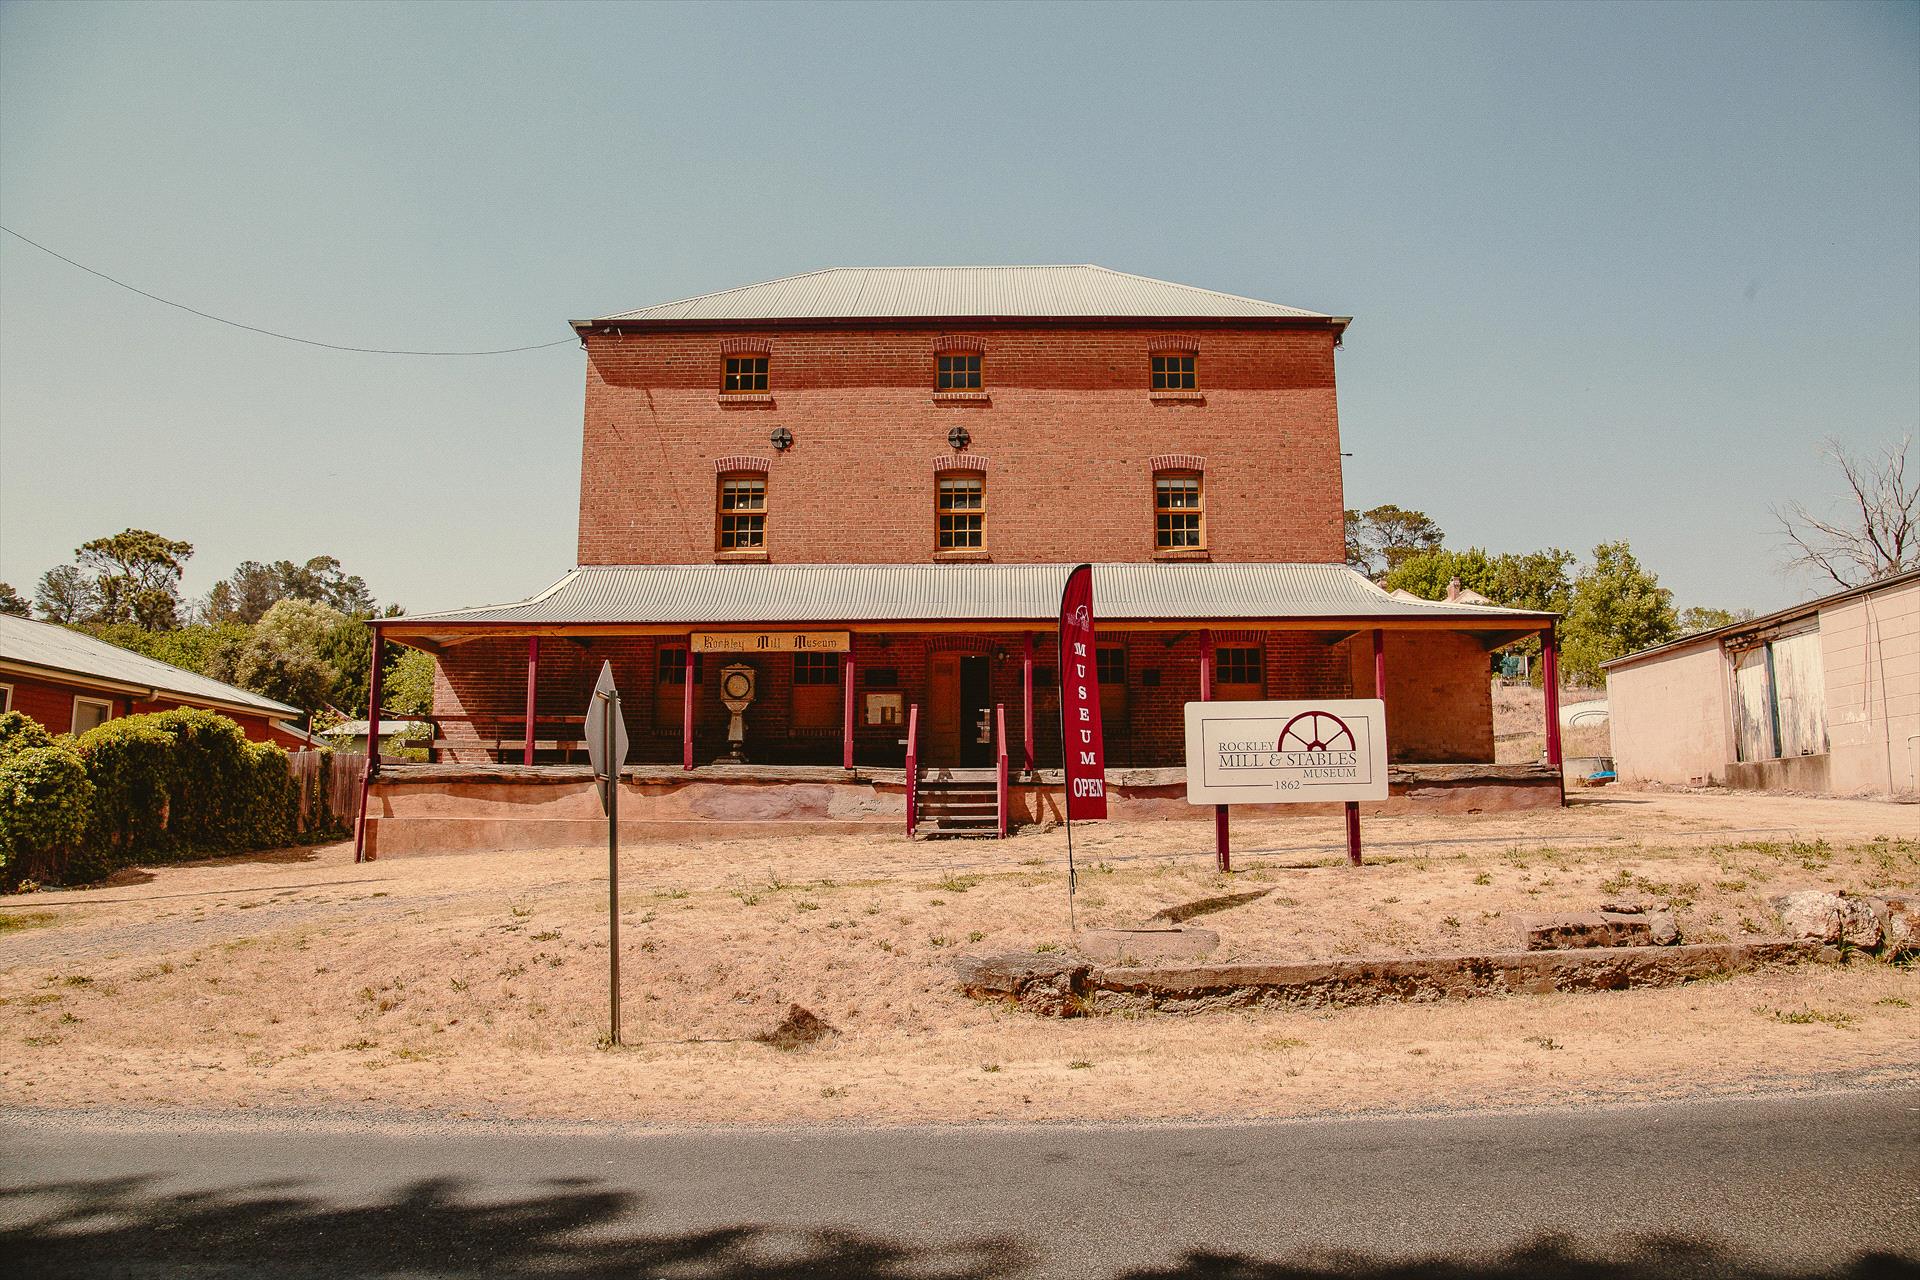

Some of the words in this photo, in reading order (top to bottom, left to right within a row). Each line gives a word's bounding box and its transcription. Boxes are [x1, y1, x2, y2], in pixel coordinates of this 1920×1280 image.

[756, 635, 781, 649] Mill
[793, 634, 837, 649] Museum
[1073, 642, 1097, 765] MUSEUM
[1219, 741, 1275, 752] ROCKLEY
[1219, 753, 1264, 768] MILL
[1269, 753, 1283, 767] &
[1286, 752, 1357, 767] STABLES
[1303, 769, 1357, 779] MUSEUM
[1073, 777, 1103, 798] OPEN
[1274, 780, 1300, 790] 1862
